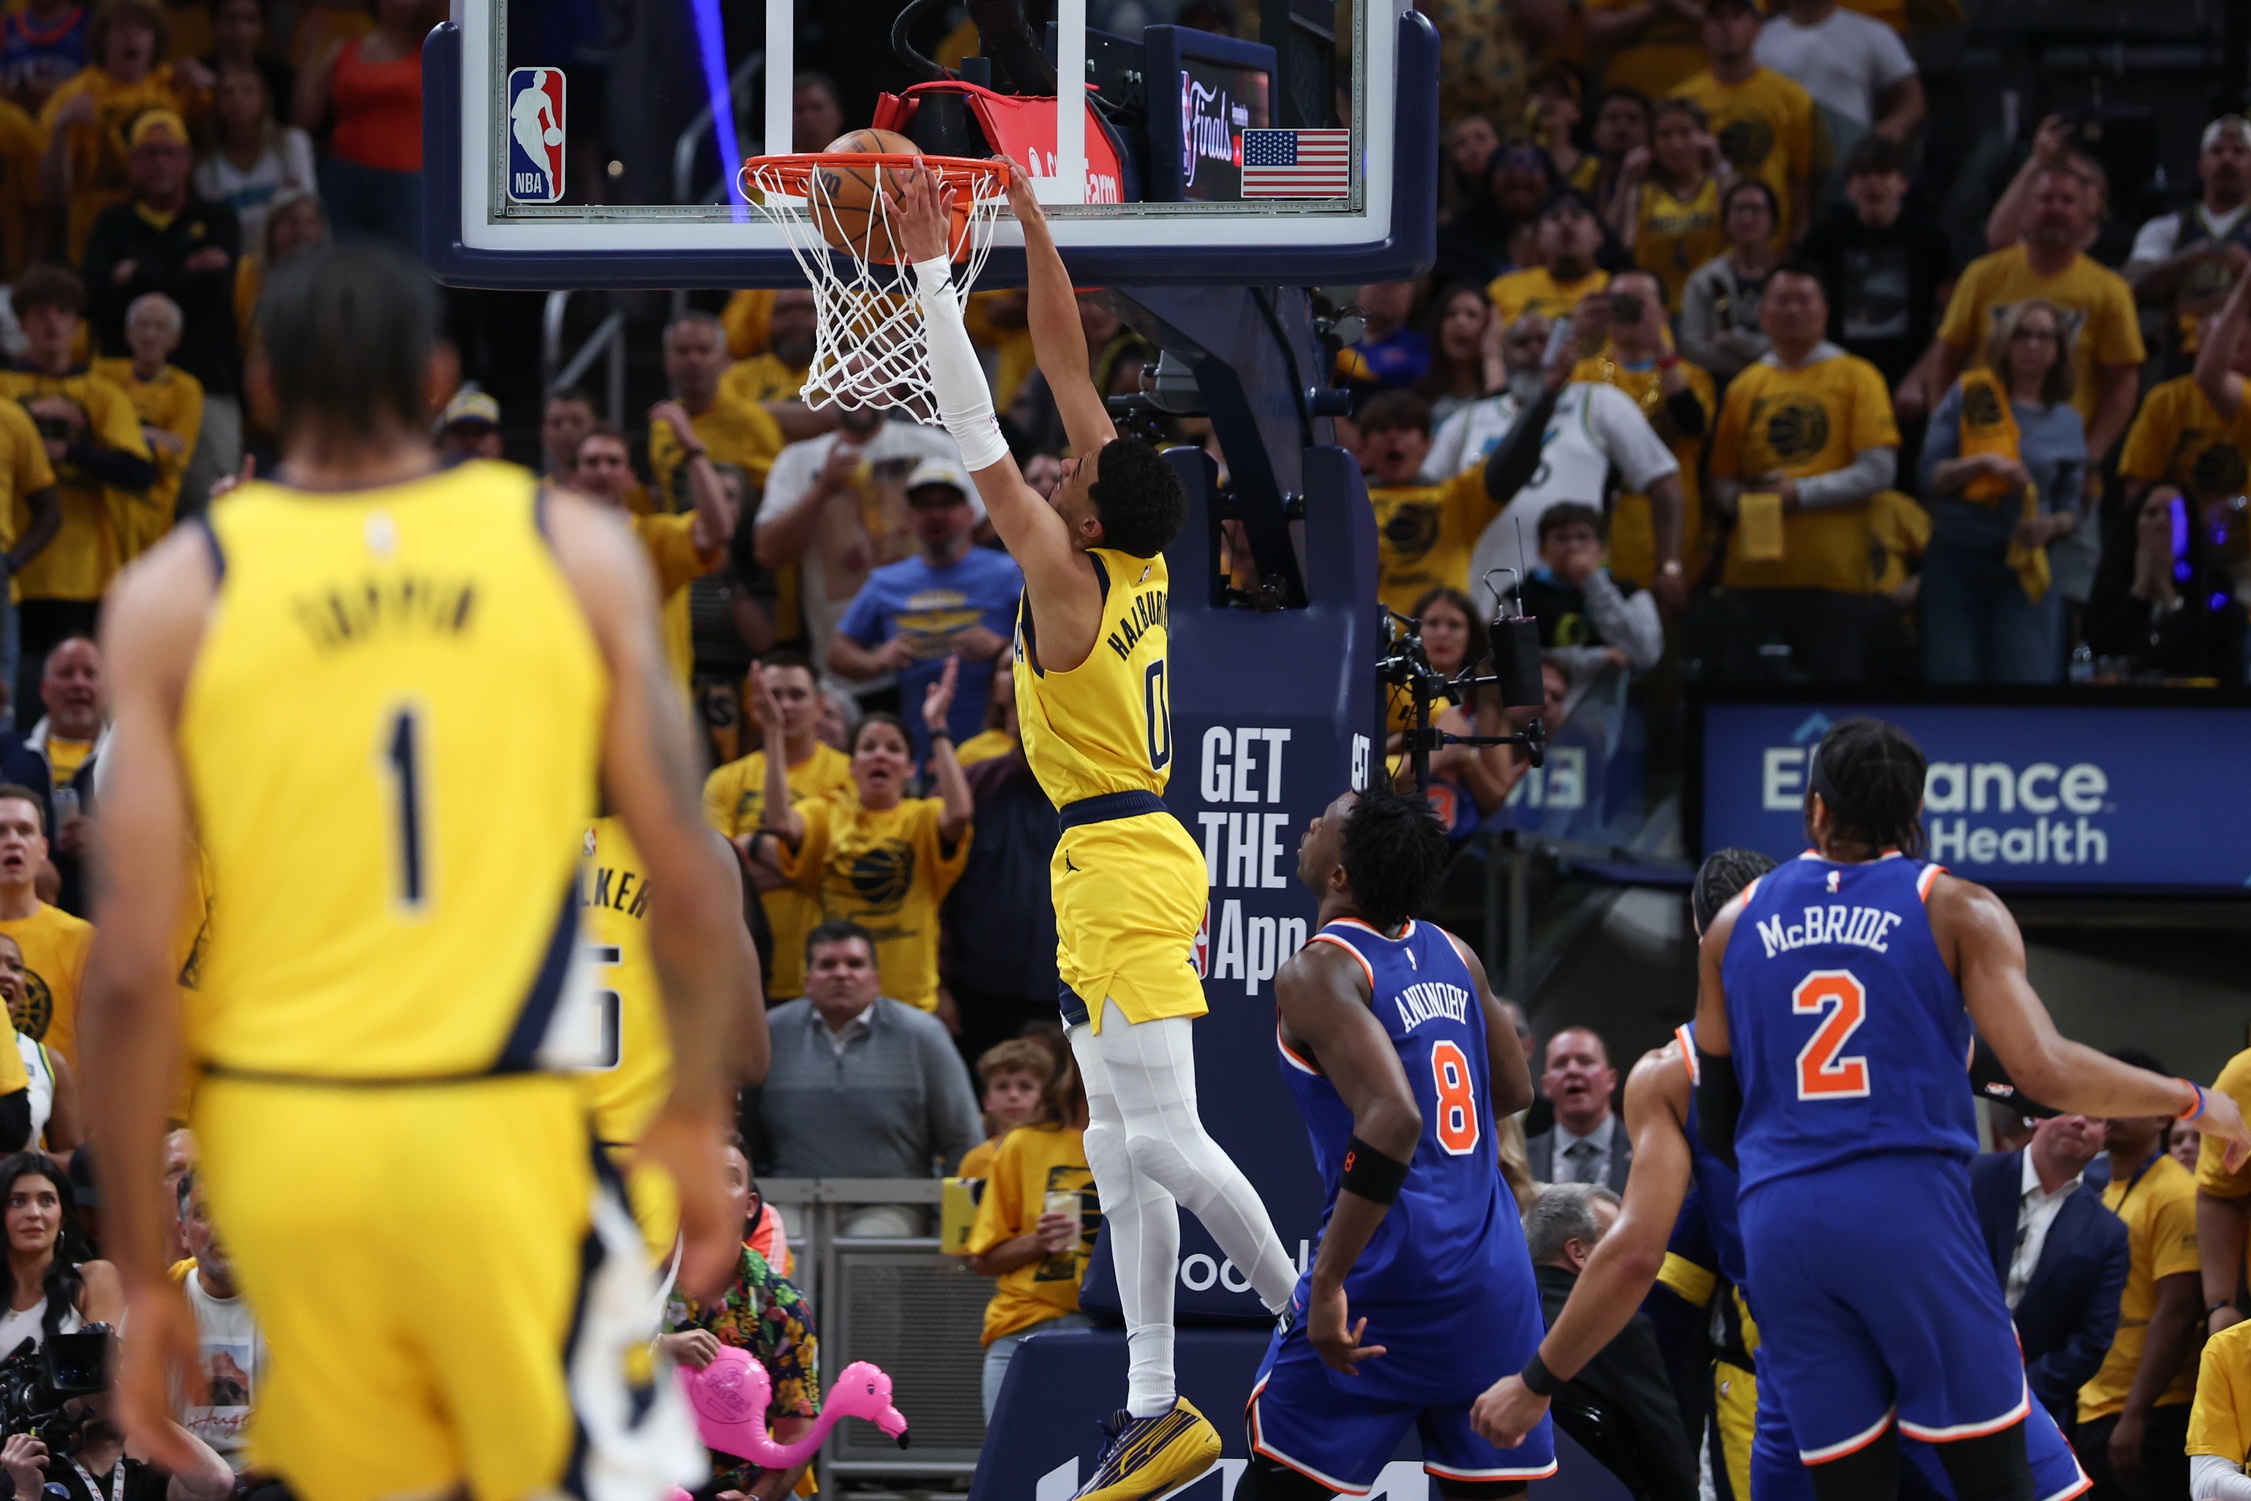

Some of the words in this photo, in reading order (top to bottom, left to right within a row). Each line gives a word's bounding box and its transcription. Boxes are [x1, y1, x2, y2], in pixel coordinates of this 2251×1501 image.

[1185, 80, 1233, 187] Finals
[515, 172, 543, 194] NBA
[1200, 725, 1292, 803] GET
[1351, 732, 1371, 791] GET
[378, 698, 432, 912] 1
[1197, 811, 1290, 889] THE
[1930, 816, 2108, 864] Health
[1756, 904, 1903, 960] McBRIDE
[1394, 981, 1469, 1034] ANUNOBY
[1792, 968, 1871, 1102] 2
[1430, 1039, 1480, 1156] 8
[1343, 1150, 1357, 1173] 8
